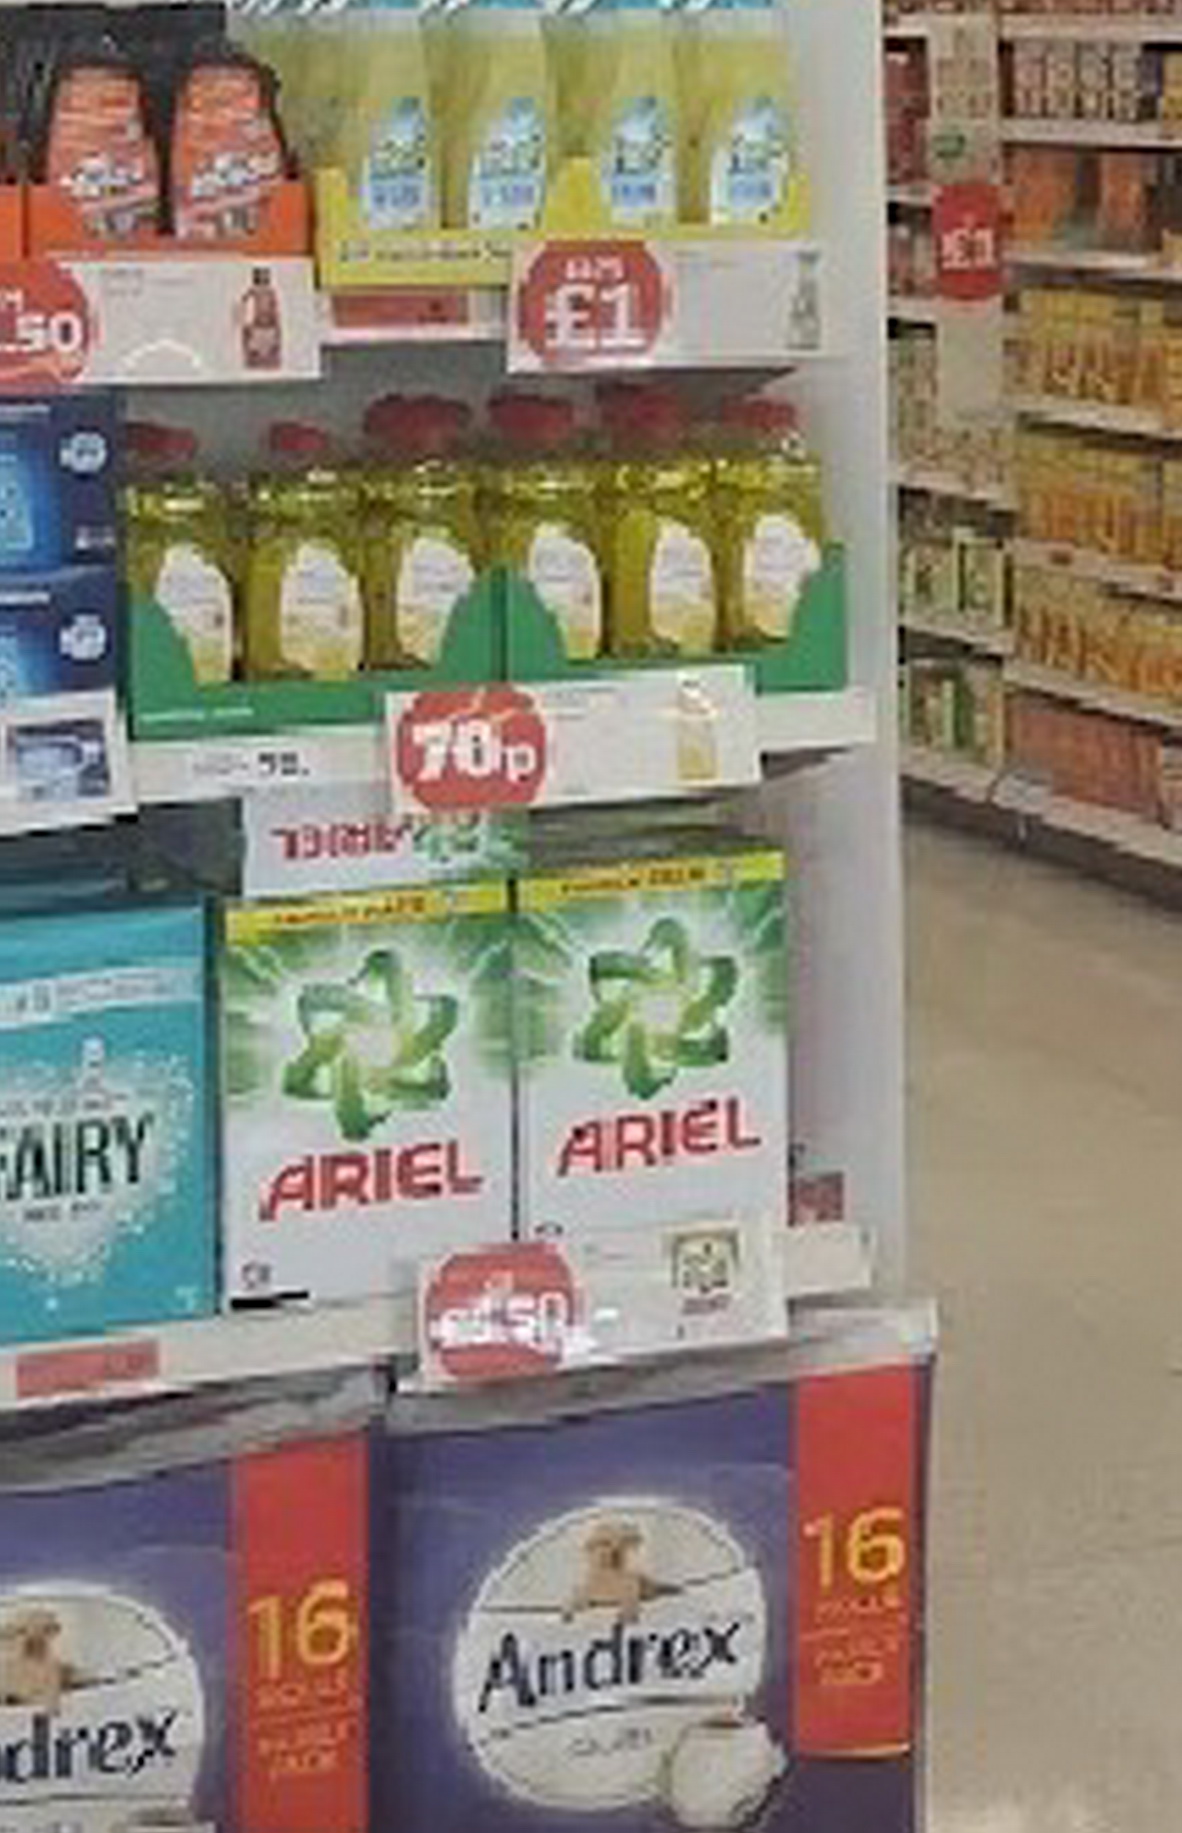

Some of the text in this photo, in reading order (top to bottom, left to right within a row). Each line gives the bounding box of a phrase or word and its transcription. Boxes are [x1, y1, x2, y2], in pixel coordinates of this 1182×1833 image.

[545, 282, 646, 351] £1
[413, 720, 537, 785] 70p
[557, 1097, 762, 1178] ARIEL
[258, 1140, 484, 1223] ARIEL
[803, 1505, 906, 1595] 16
[246, 1579, 352, 1682] 16
[478, 1621, 742, 1714] Andrex
[1, 1708, 177, 1777] drex
